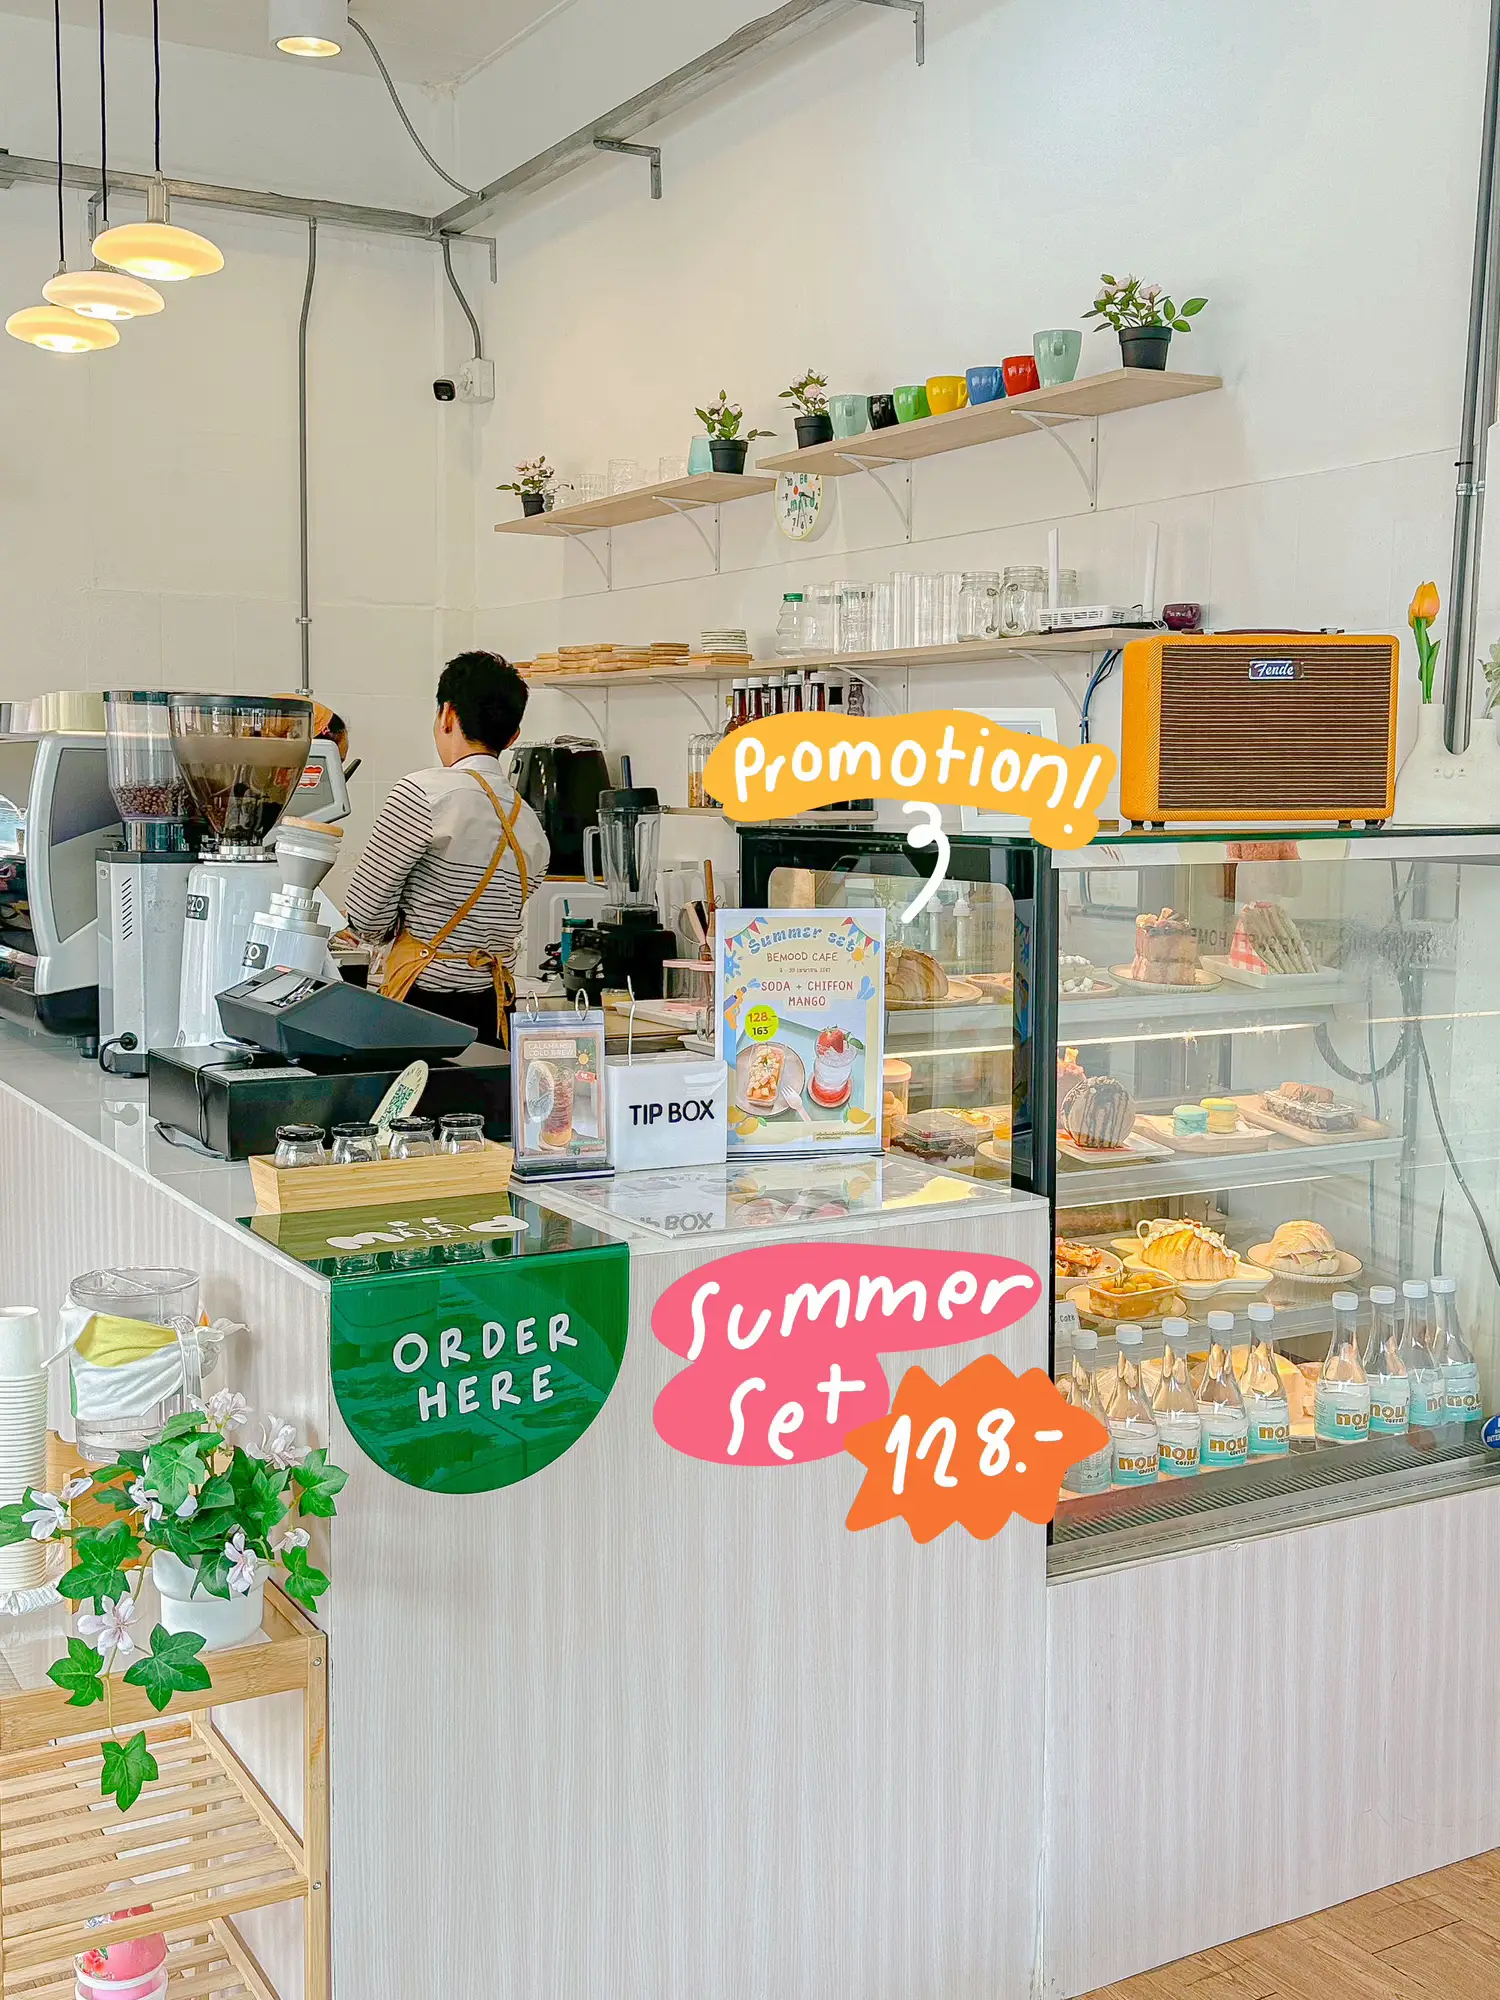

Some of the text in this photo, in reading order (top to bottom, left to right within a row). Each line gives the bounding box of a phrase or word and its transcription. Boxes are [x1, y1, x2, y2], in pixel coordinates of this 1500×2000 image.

[766, 951, 839, 963] BEMOOD CAFE
[761, 981, 791, 992] SODA
[807, 980, 854, 991] CHIFFON
[788, 996, 826, 1007] MANGO
[628, 1098, 715, 1126] TIP BOX
[392, 1313, 578, 1373] ORDER
[418, 1364, 555, 1422] HERE
